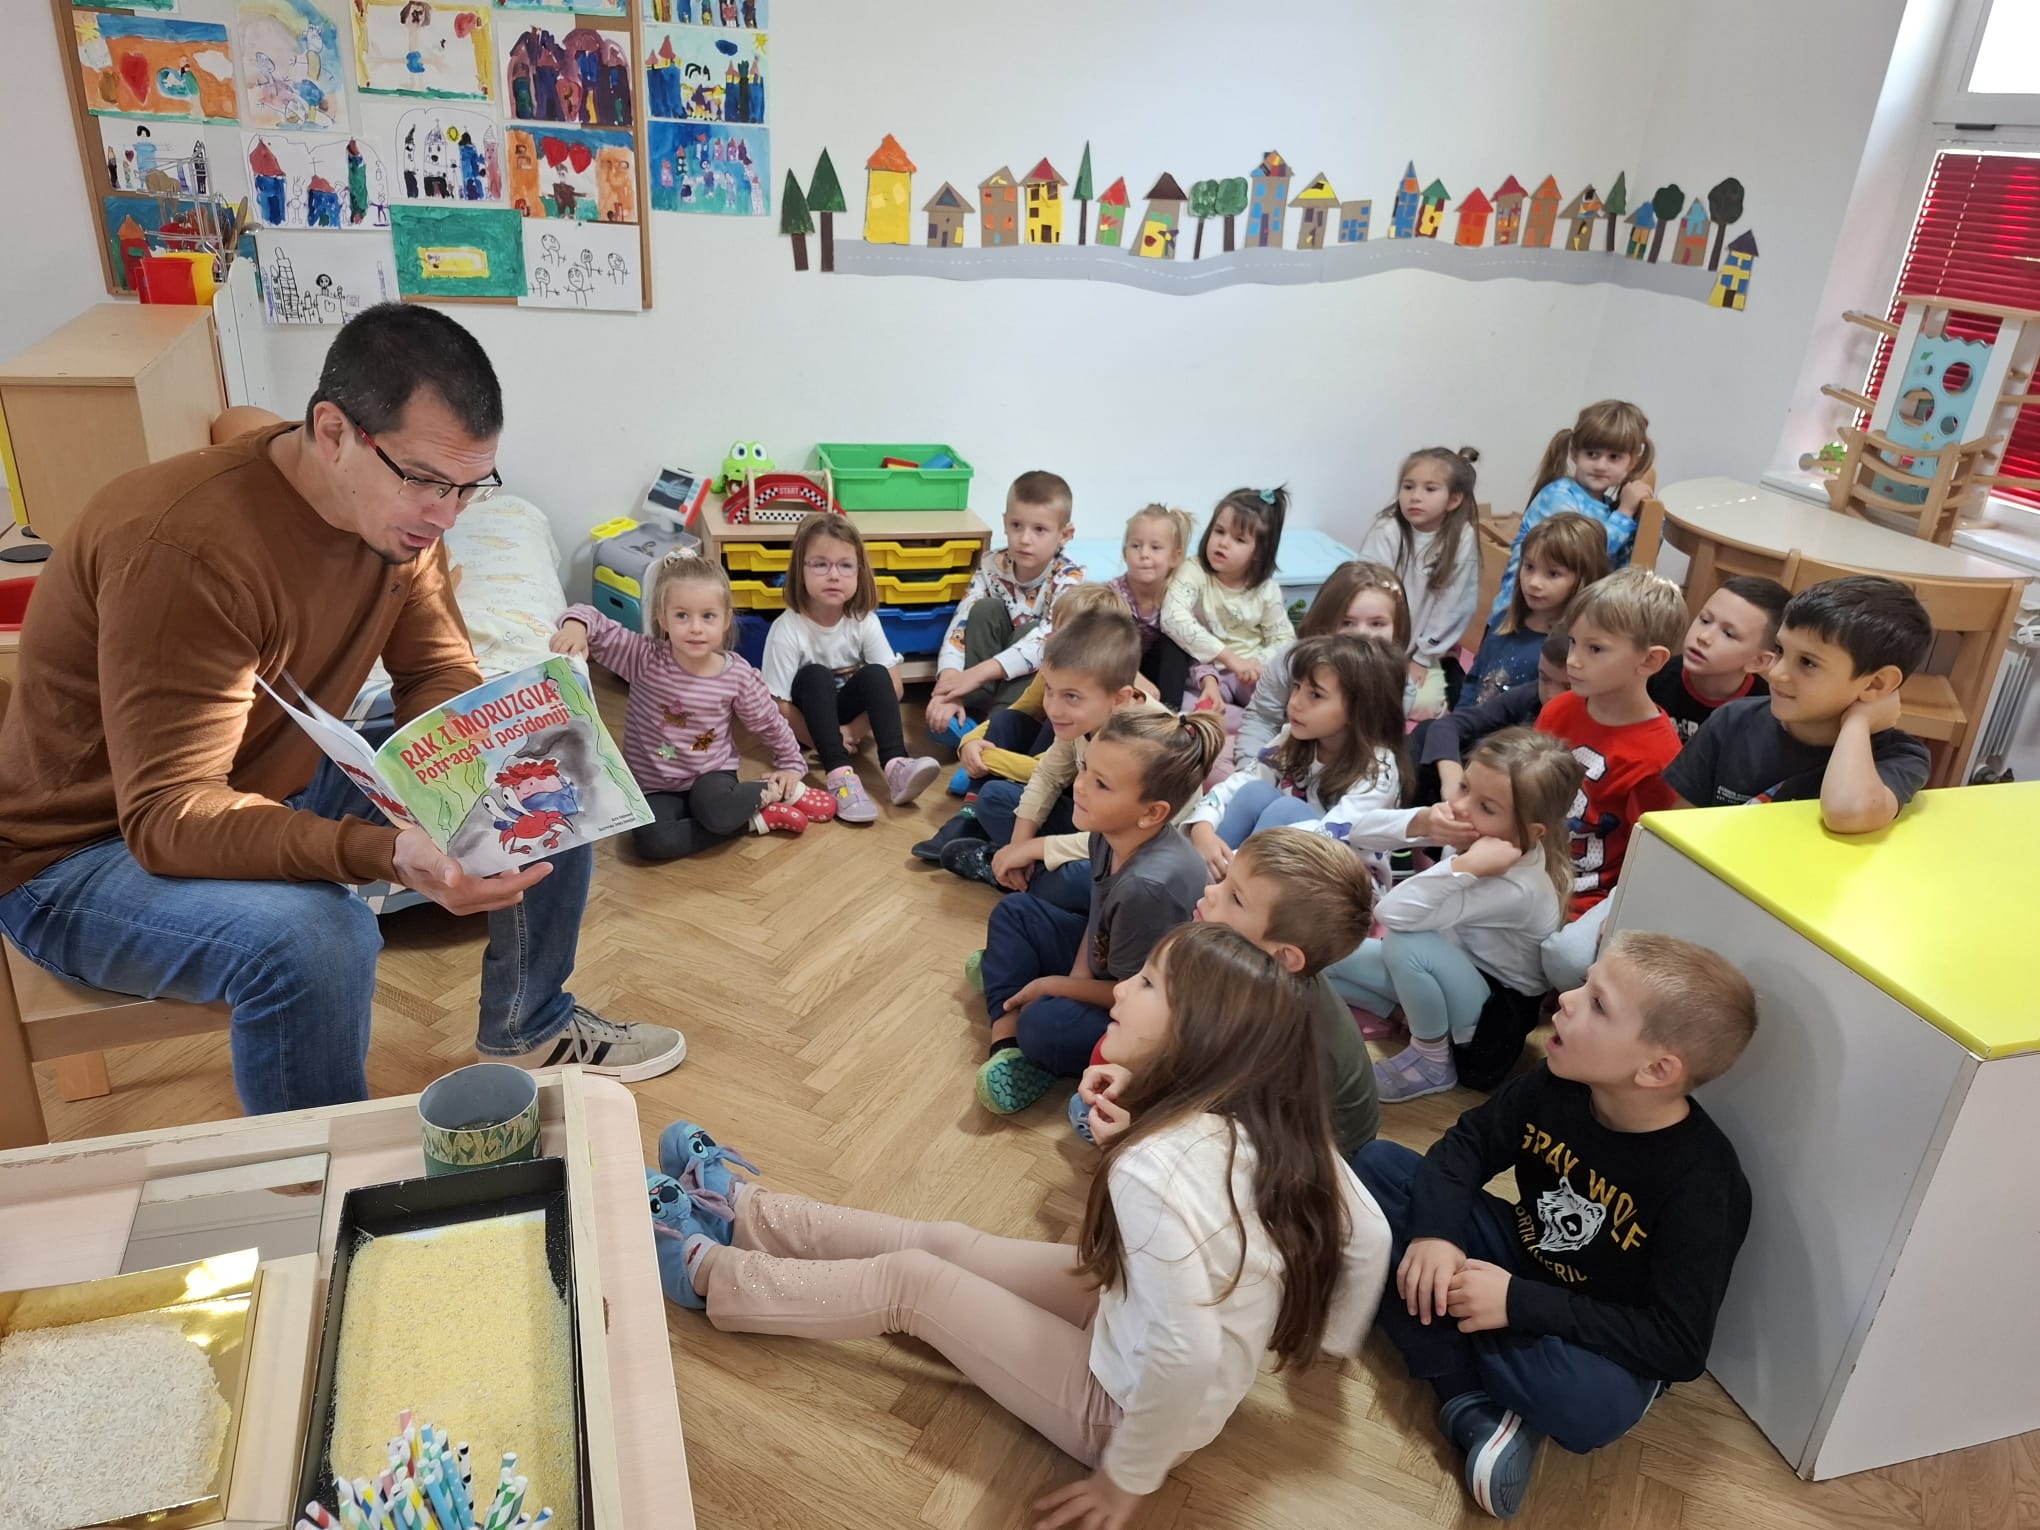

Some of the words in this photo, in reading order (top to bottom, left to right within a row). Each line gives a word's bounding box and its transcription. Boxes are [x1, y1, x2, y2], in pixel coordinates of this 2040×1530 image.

[779, 486, 799, 495] START
[400, 732, 443, 770] RAK
[437, 725, 457, 746] I
[451, 680, 560, 739] MORUZGVA
[415, 742, 481, 785] Potraga
[481, 738, 495, 750] u
[494, 703, 570, 748] posidoniji
[1589, 1168, 1648, 1251] WOLF
